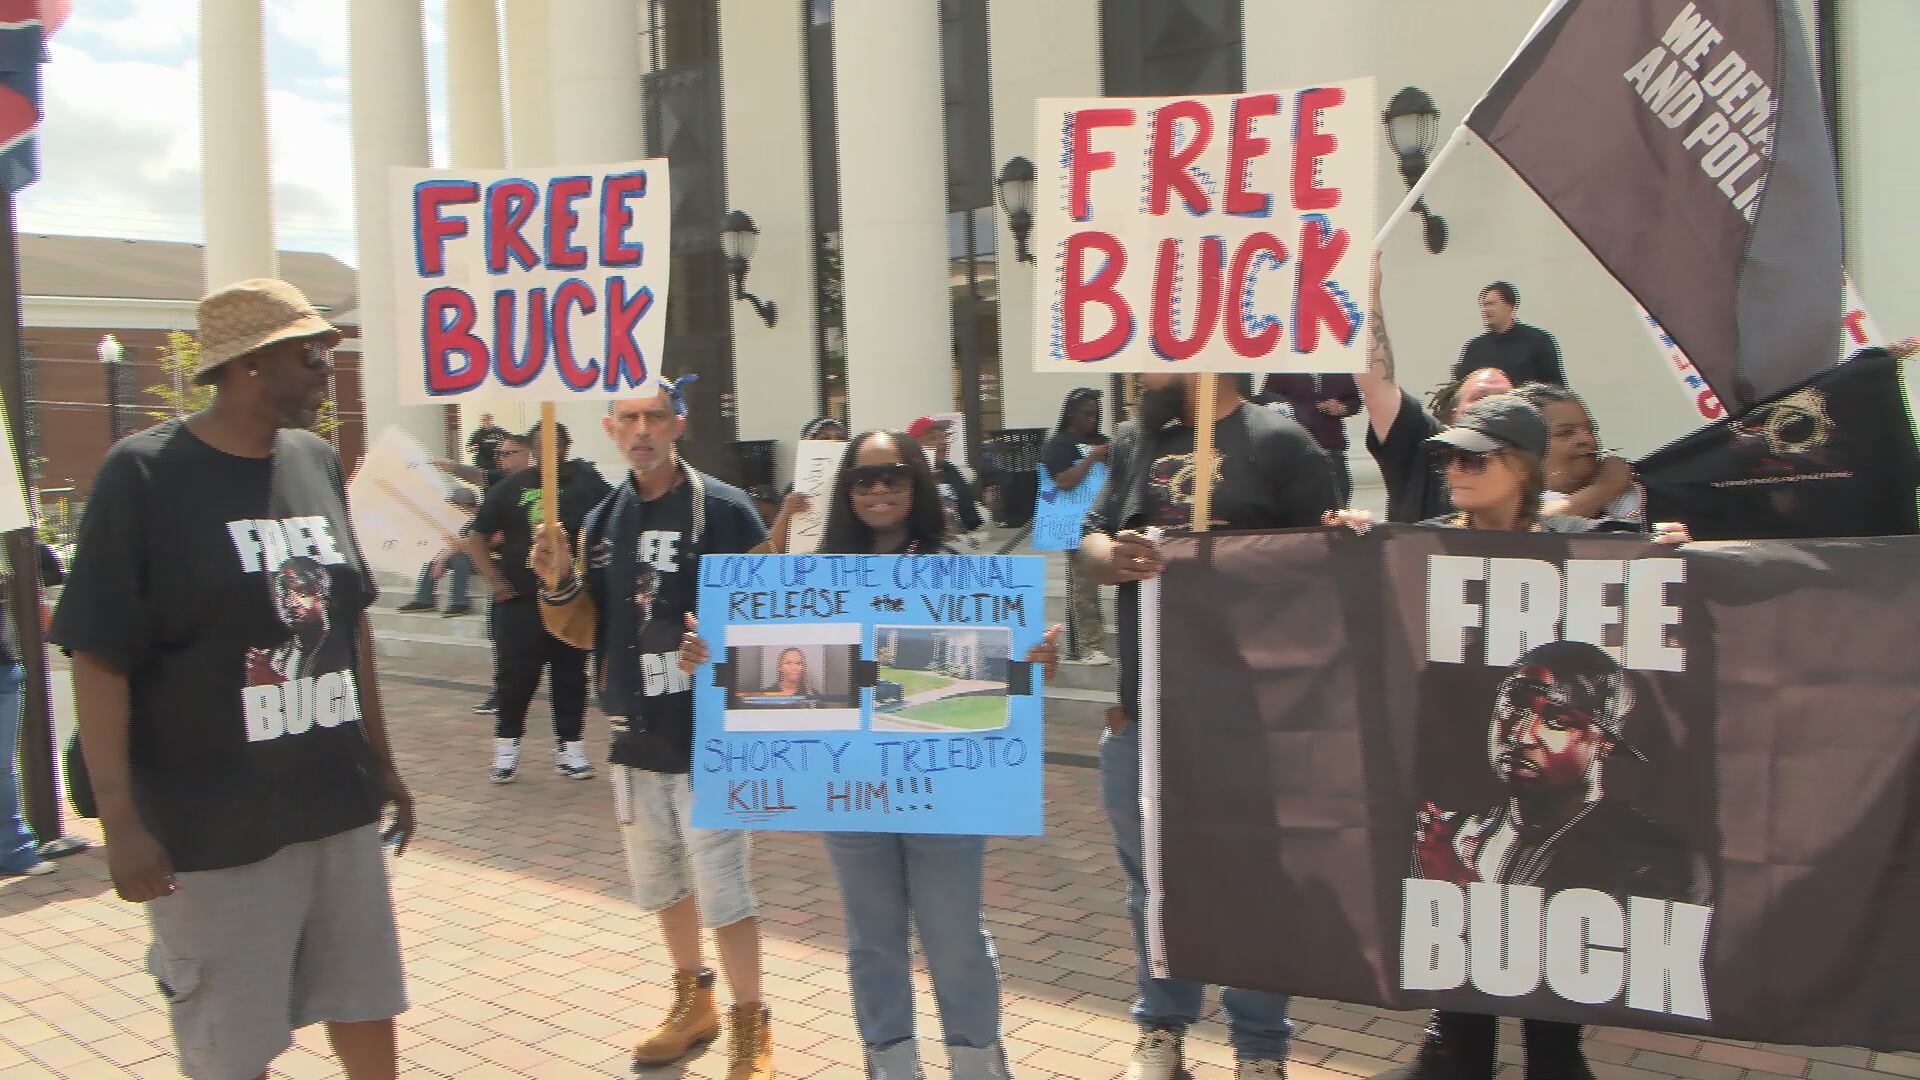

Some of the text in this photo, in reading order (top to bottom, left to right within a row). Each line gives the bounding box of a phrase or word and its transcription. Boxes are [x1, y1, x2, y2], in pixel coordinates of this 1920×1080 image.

[1660, 1, 1723, 71] WE
[1623, 46, 1704, 129] AND
[1062, 87, 1346, 222] FREE
[412, 170, 647, 278] FREE
[1049, 213, 1364, 362] BUCK
[421, 275, 654, 396] BUCK
[226, 516, 347, 573] FREE
[703, 555, 1034, 590] LOCK UP THE CRIMINAL
[728, 587, 1027, 627] RELEASE the VICTIM
[1426, 554, 1688, 672] FREE
[703, 738, 852, 774] SHORTY
[727, 776, 933, 814] KILL HIM!!!
[1402, 878, 1713, 1021] BUCK
